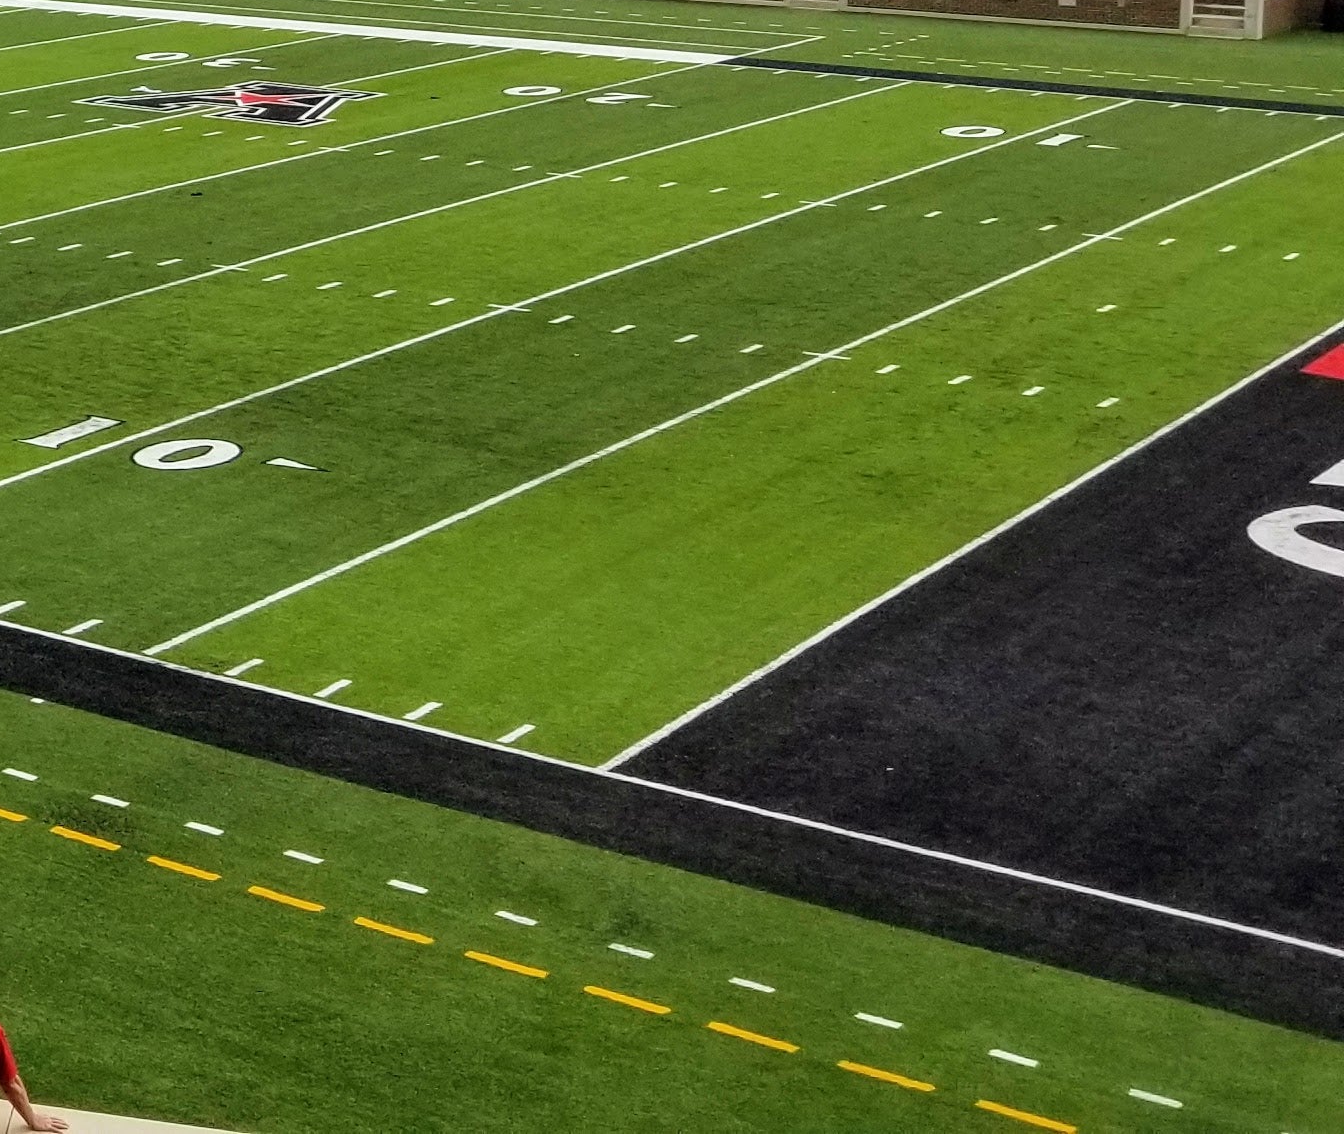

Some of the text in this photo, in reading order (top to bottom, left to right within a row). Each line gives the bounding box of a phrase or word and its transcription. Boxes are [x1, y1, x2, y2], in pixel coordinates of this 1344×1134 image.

[500, 84, 654, 105] 20
[939, 124, 1088, 147] 10
[16, 413, 244, 473] 10
